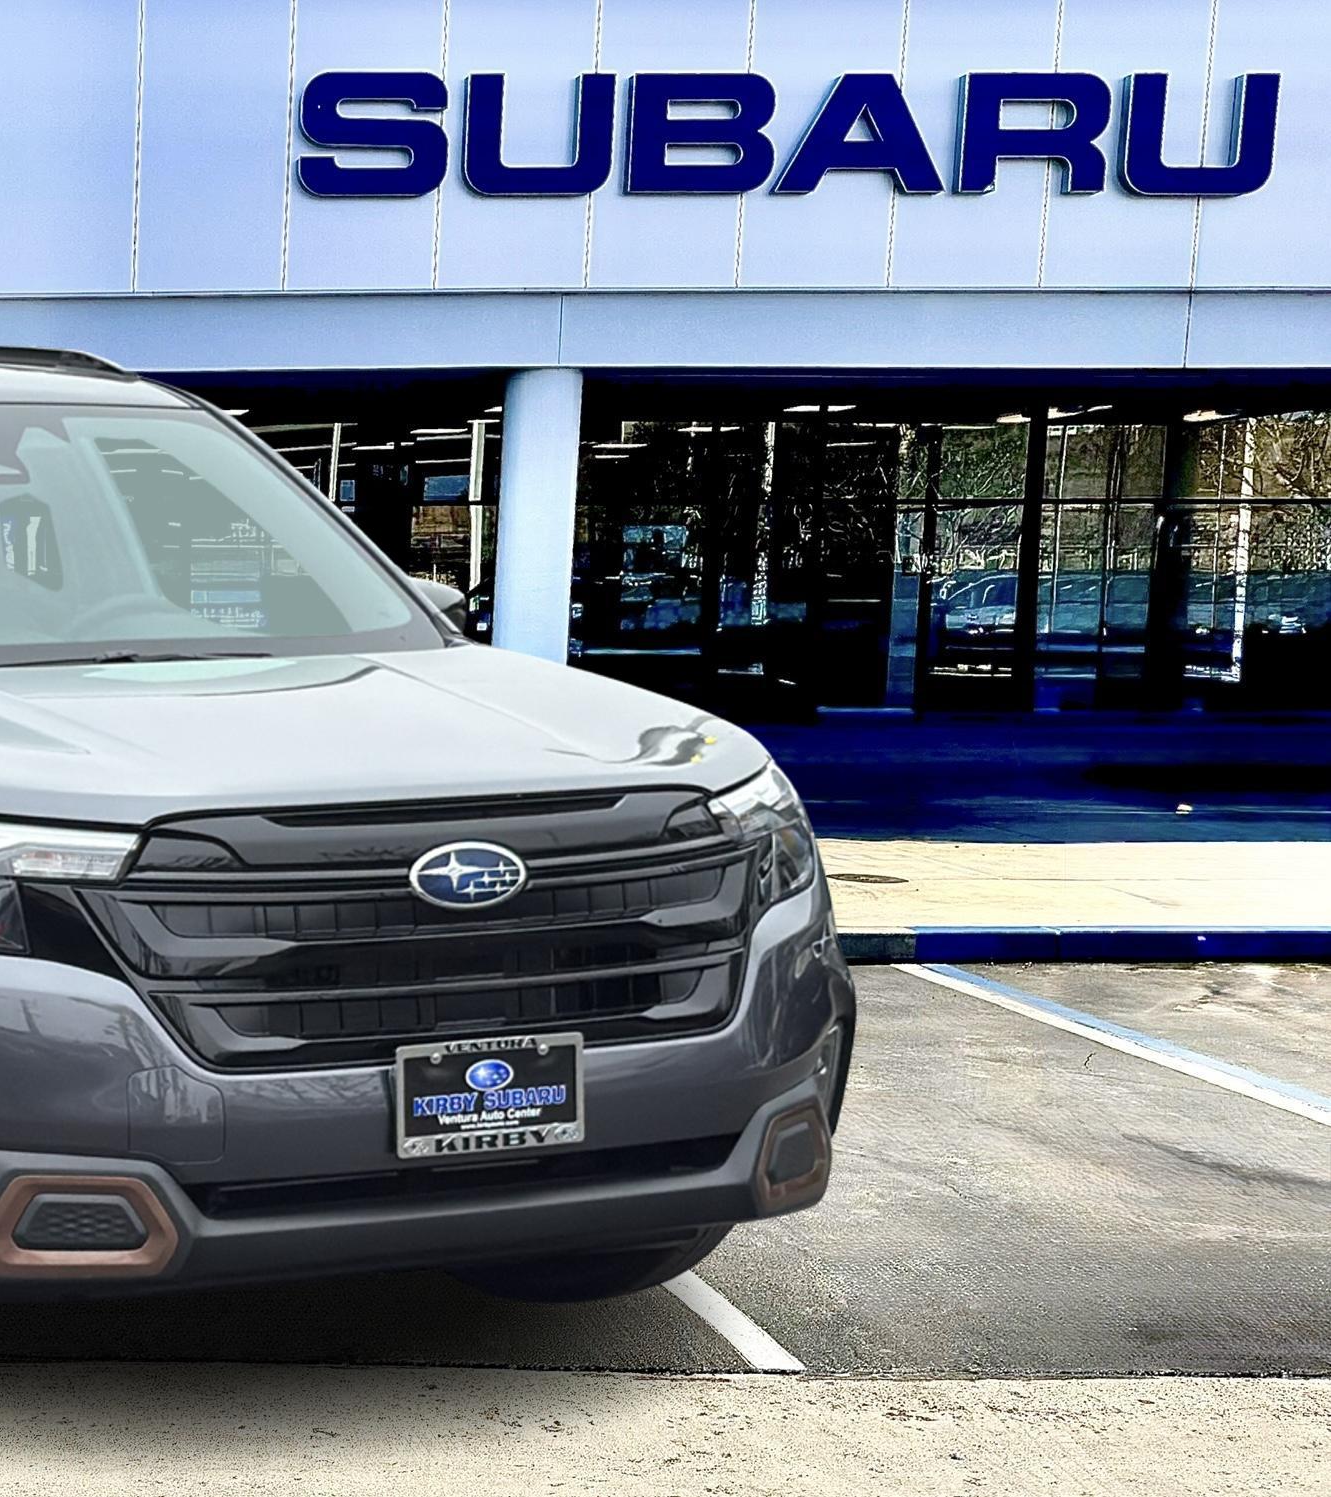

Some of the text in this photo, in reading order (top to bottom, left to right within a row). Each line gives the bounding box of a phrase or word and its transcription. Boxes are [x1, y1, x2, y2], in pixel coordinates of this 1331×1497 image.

[297, 71, 1282, 200] SUBARU
[445, 1038, 537, 1054] VENTURA
[413, 1085, 566, 1116] KIRBY SUBARU
[437, 1106, 542, 1126] Ventura Auto Center
[435, 1130, 550, 1153] KIRBY
